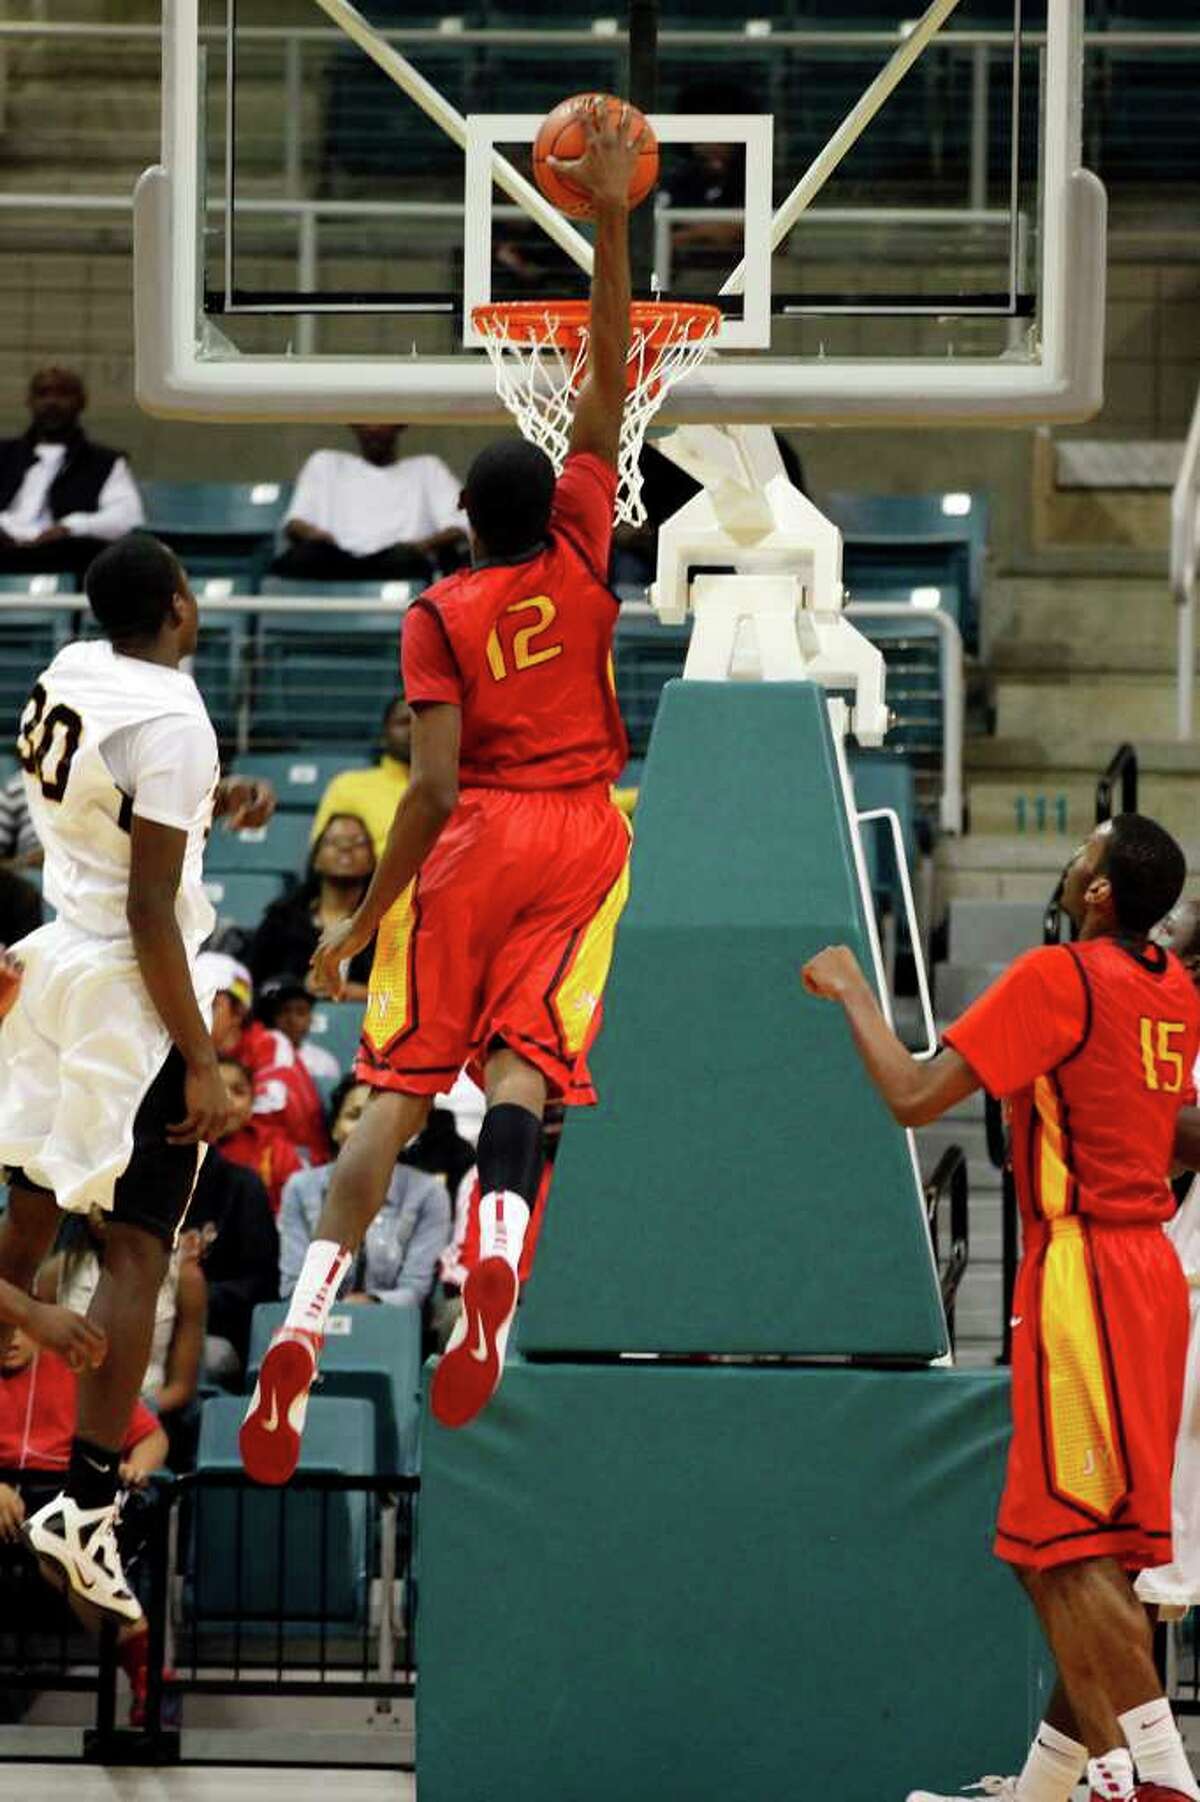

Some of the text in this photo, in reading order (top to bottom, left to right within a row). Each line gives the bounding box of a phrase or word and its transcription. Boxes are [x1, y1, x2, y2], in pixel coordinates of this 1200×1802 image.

[485, 594, 562, 681] 12
[1013, 793, 1069, 835] 111
[1140, 1017, 1186, 1093] 15
